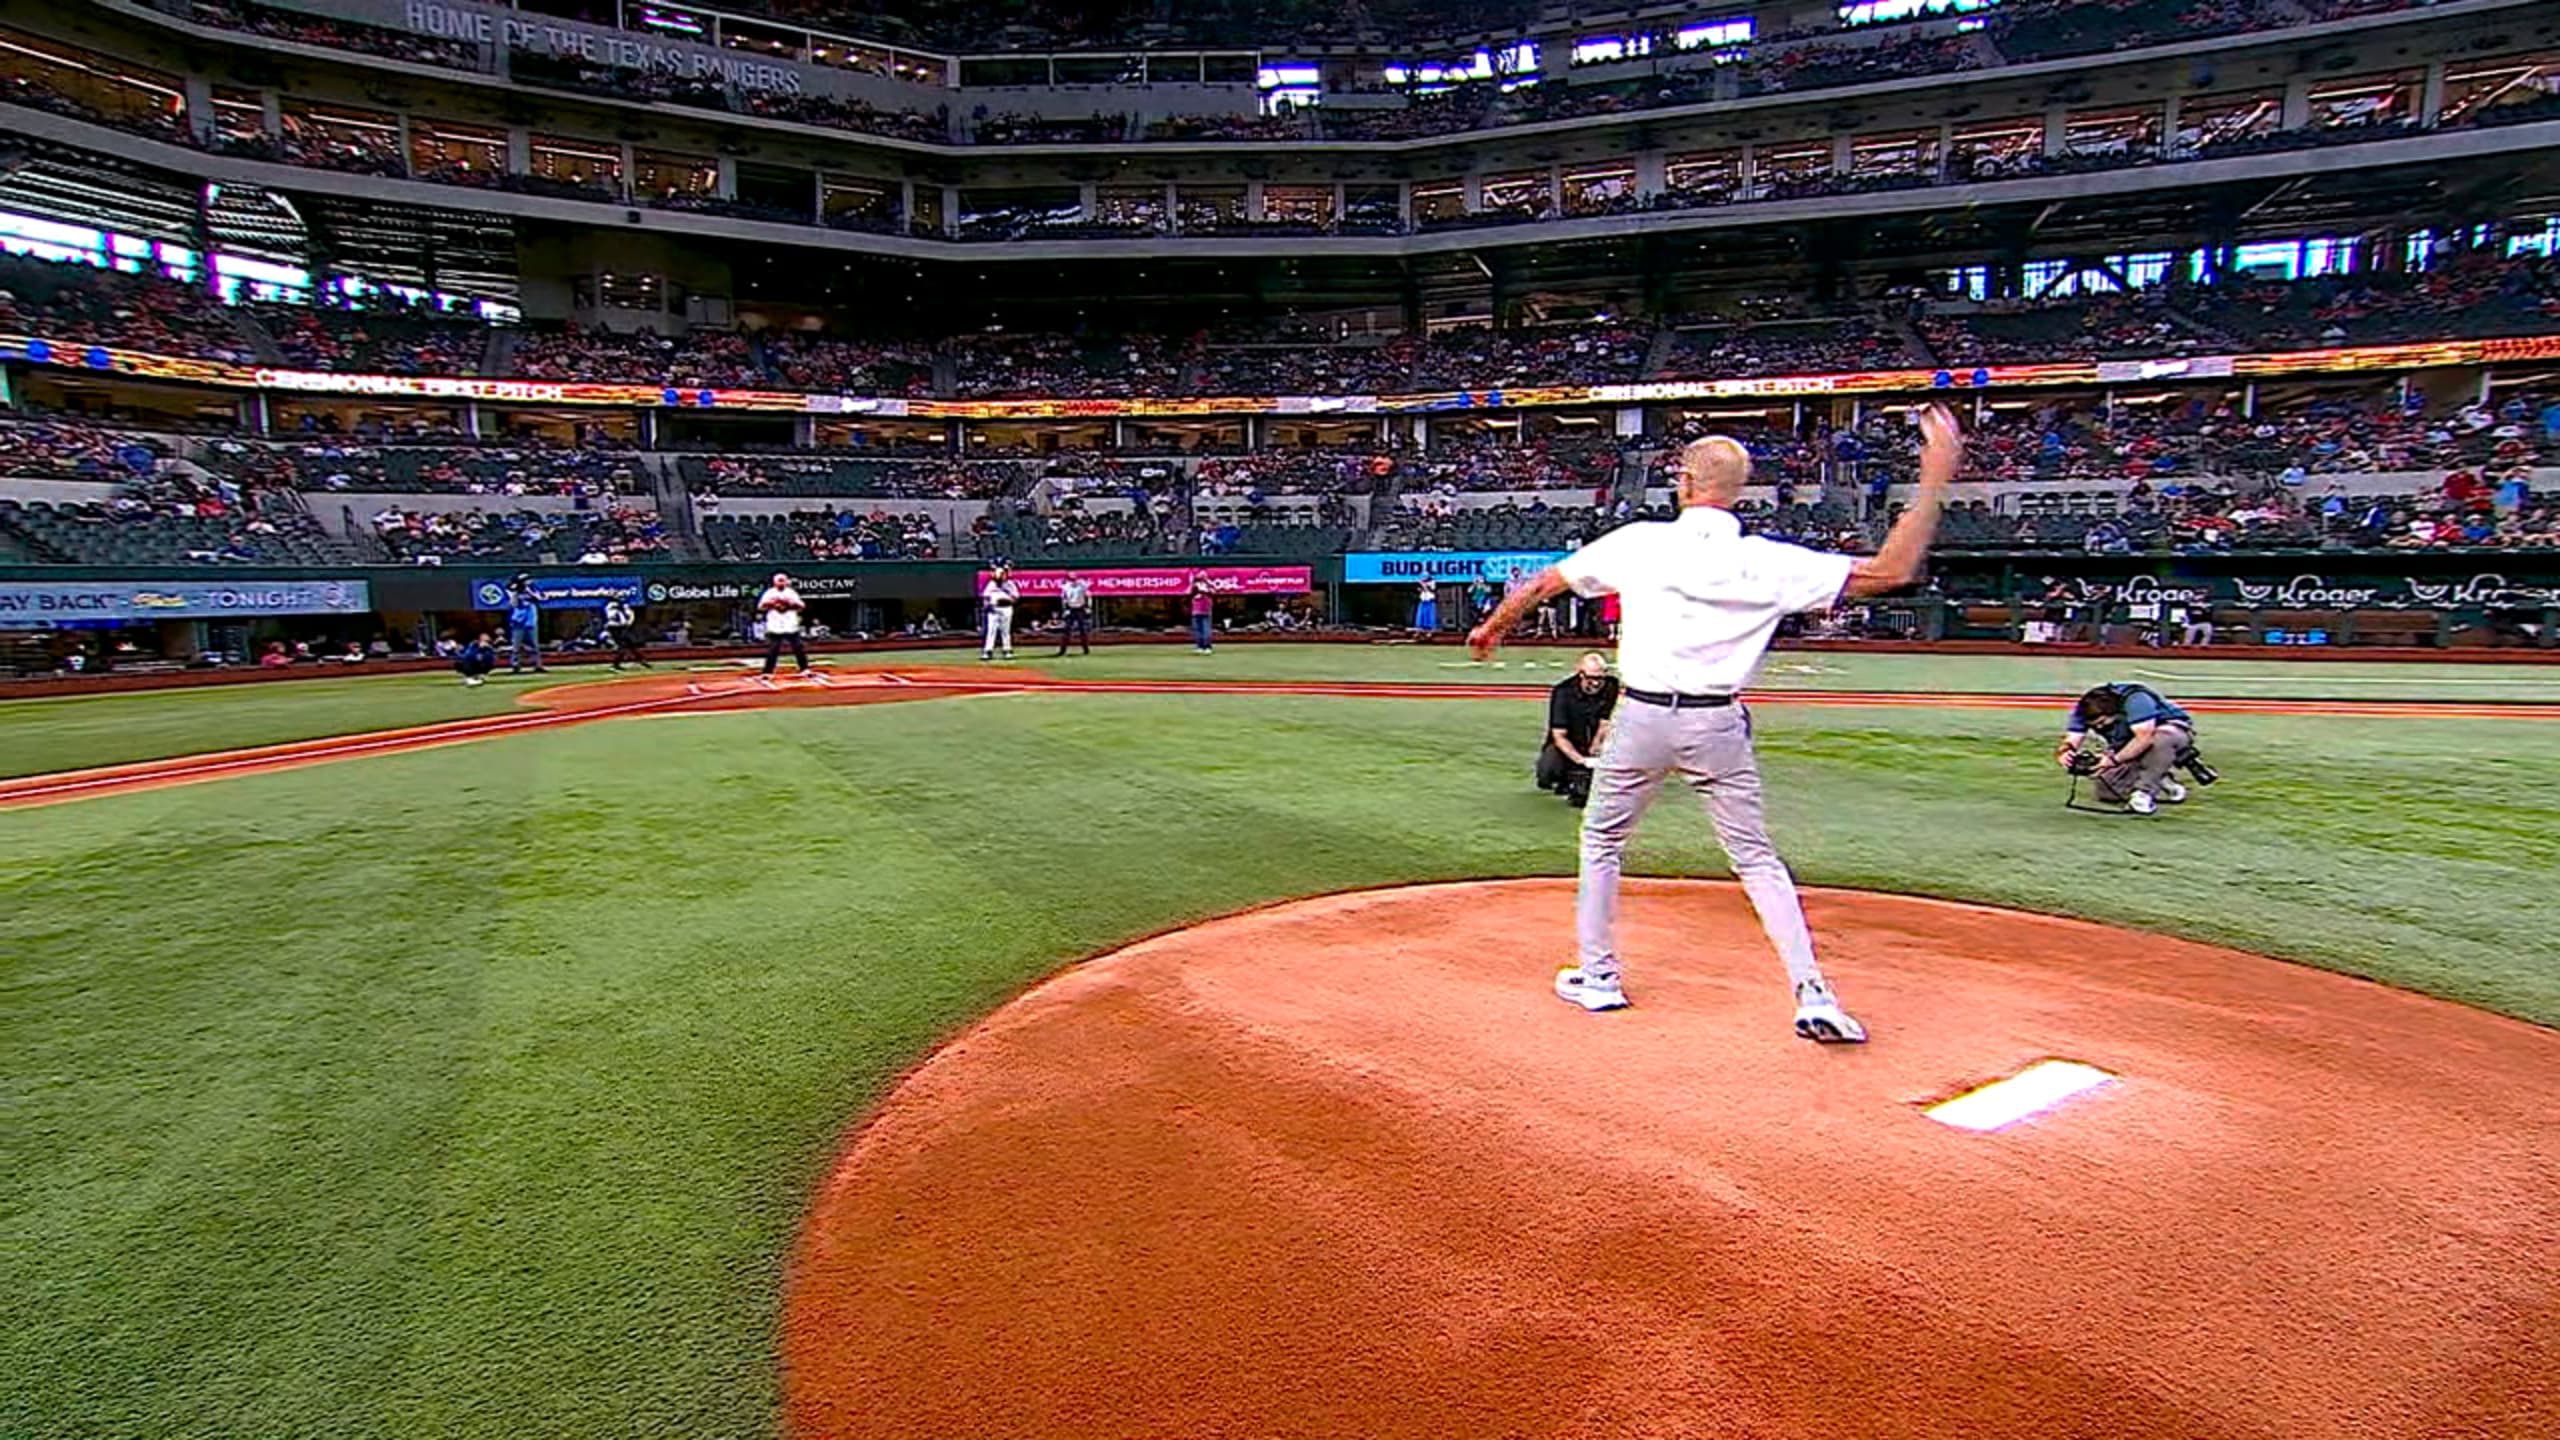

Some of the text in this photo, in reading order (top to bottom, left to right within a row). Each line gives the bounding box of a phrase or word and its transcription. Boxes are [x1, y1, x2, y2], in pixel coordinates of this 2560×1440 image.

[405, 2, 492, 42] HOME
[545, 26, 597, 62] THE
[604, 37, 684, 74] TEXAS
[693, 53, 801, 93] RANGERS
[256, 369, 560, 401] CEREMONIAL FIRST PITCH
[1588, 376, 1834, 402] CEREMONIAL FIRST PITCH
[1382, 560, 1427, 576] BUD
[1427, 560, 1486, 575] LIGHT
[669, 584, 711, 599] Globe
[713, 583, 739, 598] Life
[1097, 576, 1182, 588] MEMBERSHIP
[2276, 574, 2377, 603] Kroger
[2453, 573, 2560, 603] Krr
[206, 591, 312, 609] TONIGHT
